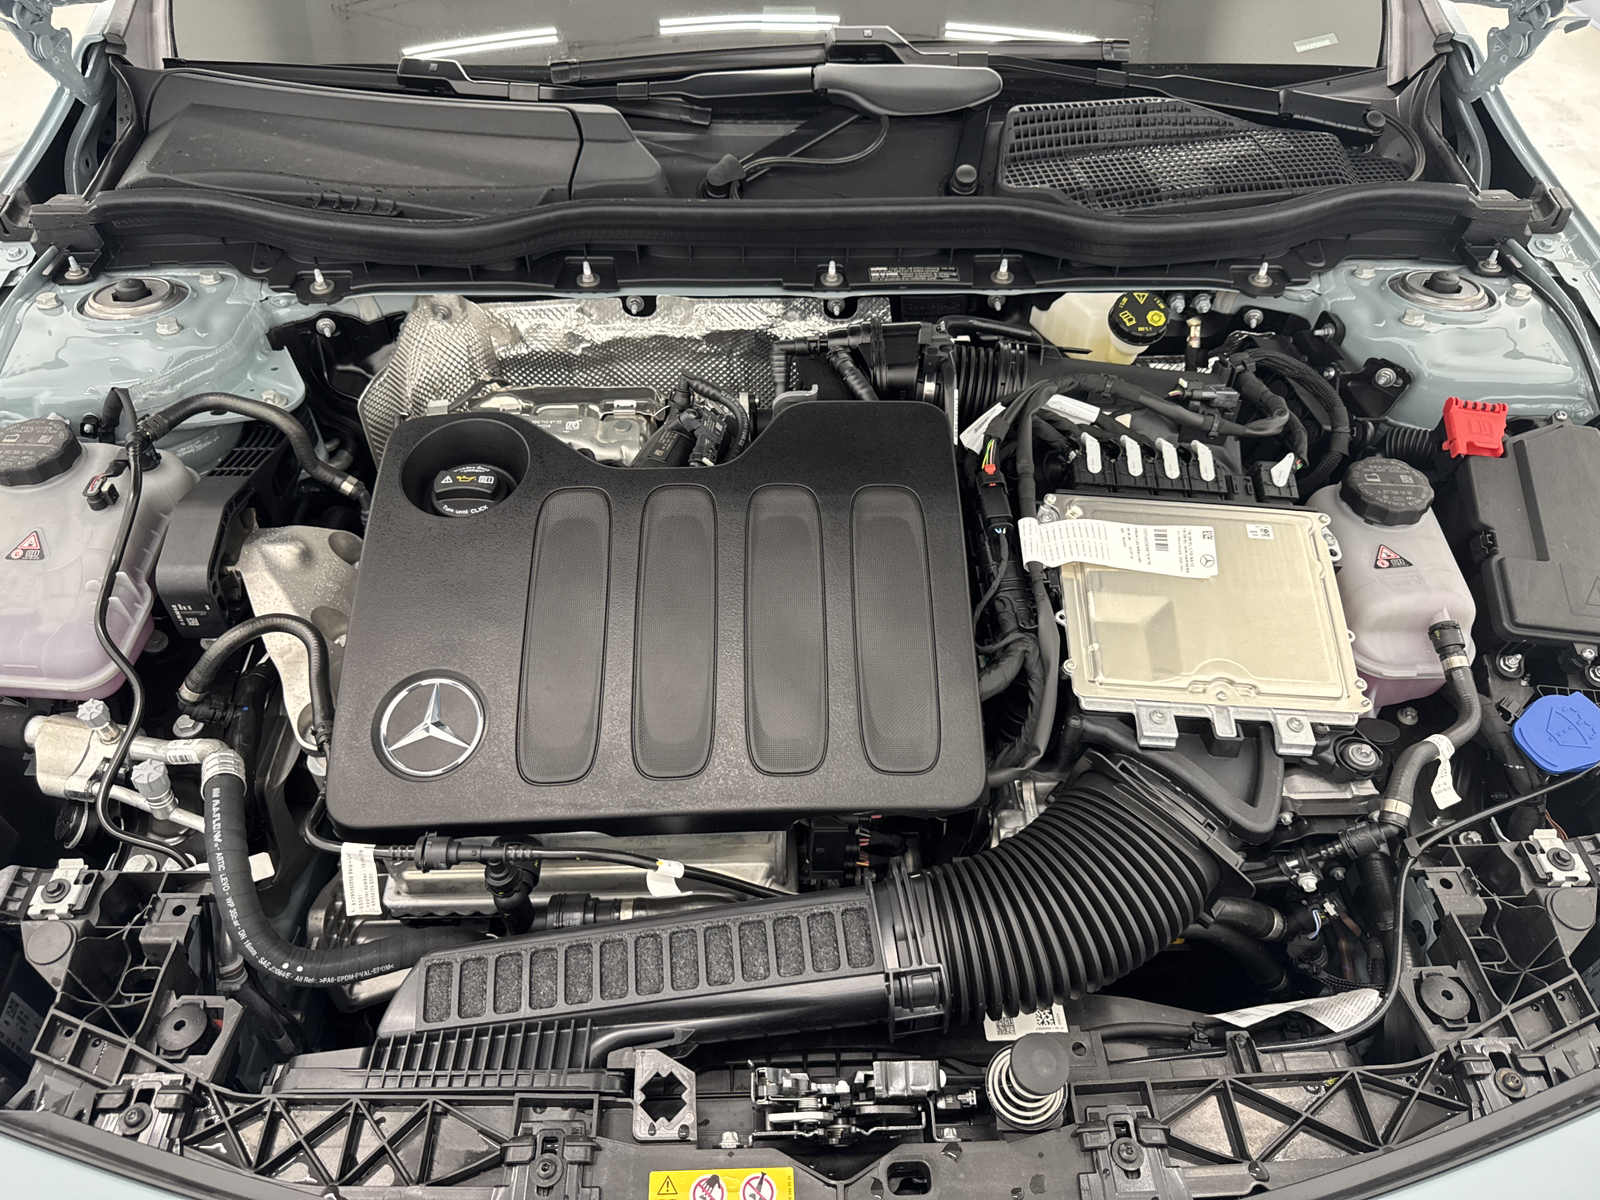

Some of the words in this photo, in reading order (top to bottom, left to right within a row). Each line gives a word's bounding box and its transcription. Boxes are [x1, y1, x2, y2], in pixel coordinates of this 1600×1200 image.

[442, 504, 455, 514] Turn
[470, 504, 489, 514] CLICK
[216, 852, 226, 872] ARTIC
[219, 873, 230, 896] LEVO
[225, 896, 234, 907] WP
[229, 906, 241, 928] 35bar
[237, 929, 246, 941] DN
[258, 956, 271, 969] SAE
